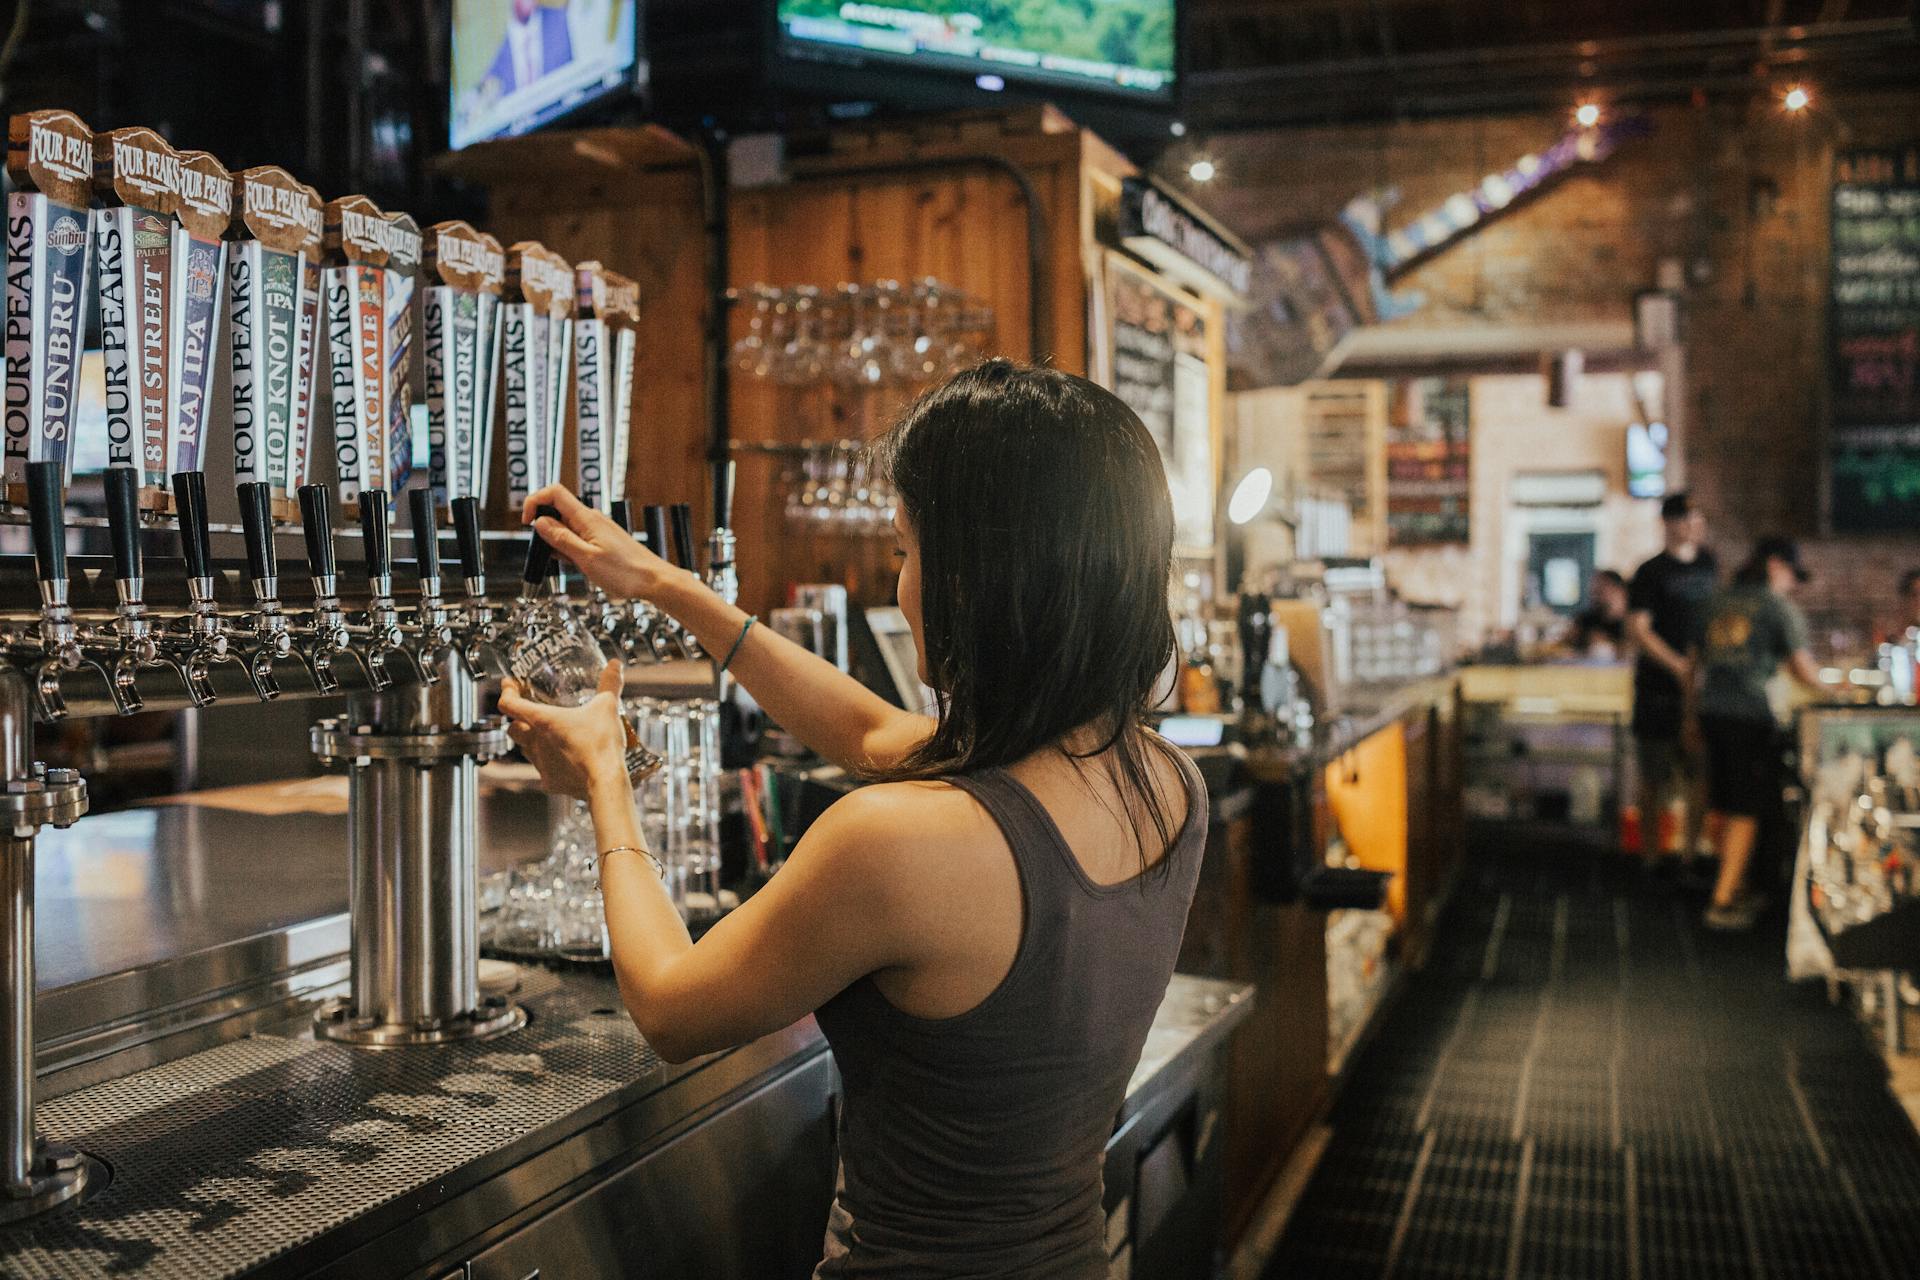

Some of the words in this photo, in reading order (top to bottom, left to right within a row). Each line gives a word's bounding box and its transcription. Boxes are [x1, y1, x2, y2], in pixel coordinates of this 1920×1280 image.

[30, 125, 64, 164] FOUR
[65, 136, 94, 179] PEAK
[113, 142, 144, 180] FOUR
[146, 150, 180, 195] PEAKS
[180, 167, 203, 199] OUR
[204, 175, 233, 216] PEAKS
[47, 231, 87, 247] Sunbru
[244, 180, 274, 214] FOUR
[275, 188, 309, 228] PEAKS
[7, 214, 33, 344] PEAKS
[100, 228, 126, 352] PEAKS
[136, 248, 157, 258] PALE
[143, 263, 163, 391] STREET
[230, 259, 252, 373] PEAKS
[266, 292, 294, 310] IPA
[328, 284, 353, 390] PEAKS
[362, 313, 379, 372] ALE
[43, 275, 76, 442] SUNBRU
[183, 316, 207, 378] IPA
[268, 313, 288, 409] KNOT
[425, 303, 444, 398] PEAKS
[505, 319, 526, 409] PEAKS
[577, 334, 598, 419] PEAKS
[5, 351, 30, 461] FOUR
[105, 359, 132, 466] FOUR
[144, 397, 163, 463] 8TH
[177, 381, 202, 446] RAJ
[232, 380, 255, 476] FOUR
[267, 410, 286, 487] HOP
[335, 397, 359, 483] FOUR
[364, 376, 382, 477] PEACH
[429, 409, 447, 488] FOUR
[456, 331, 474, 497] PITCHFORK
[507, 418, 528, 492] FOUR
[580, 426, 601, 498] FOUR
